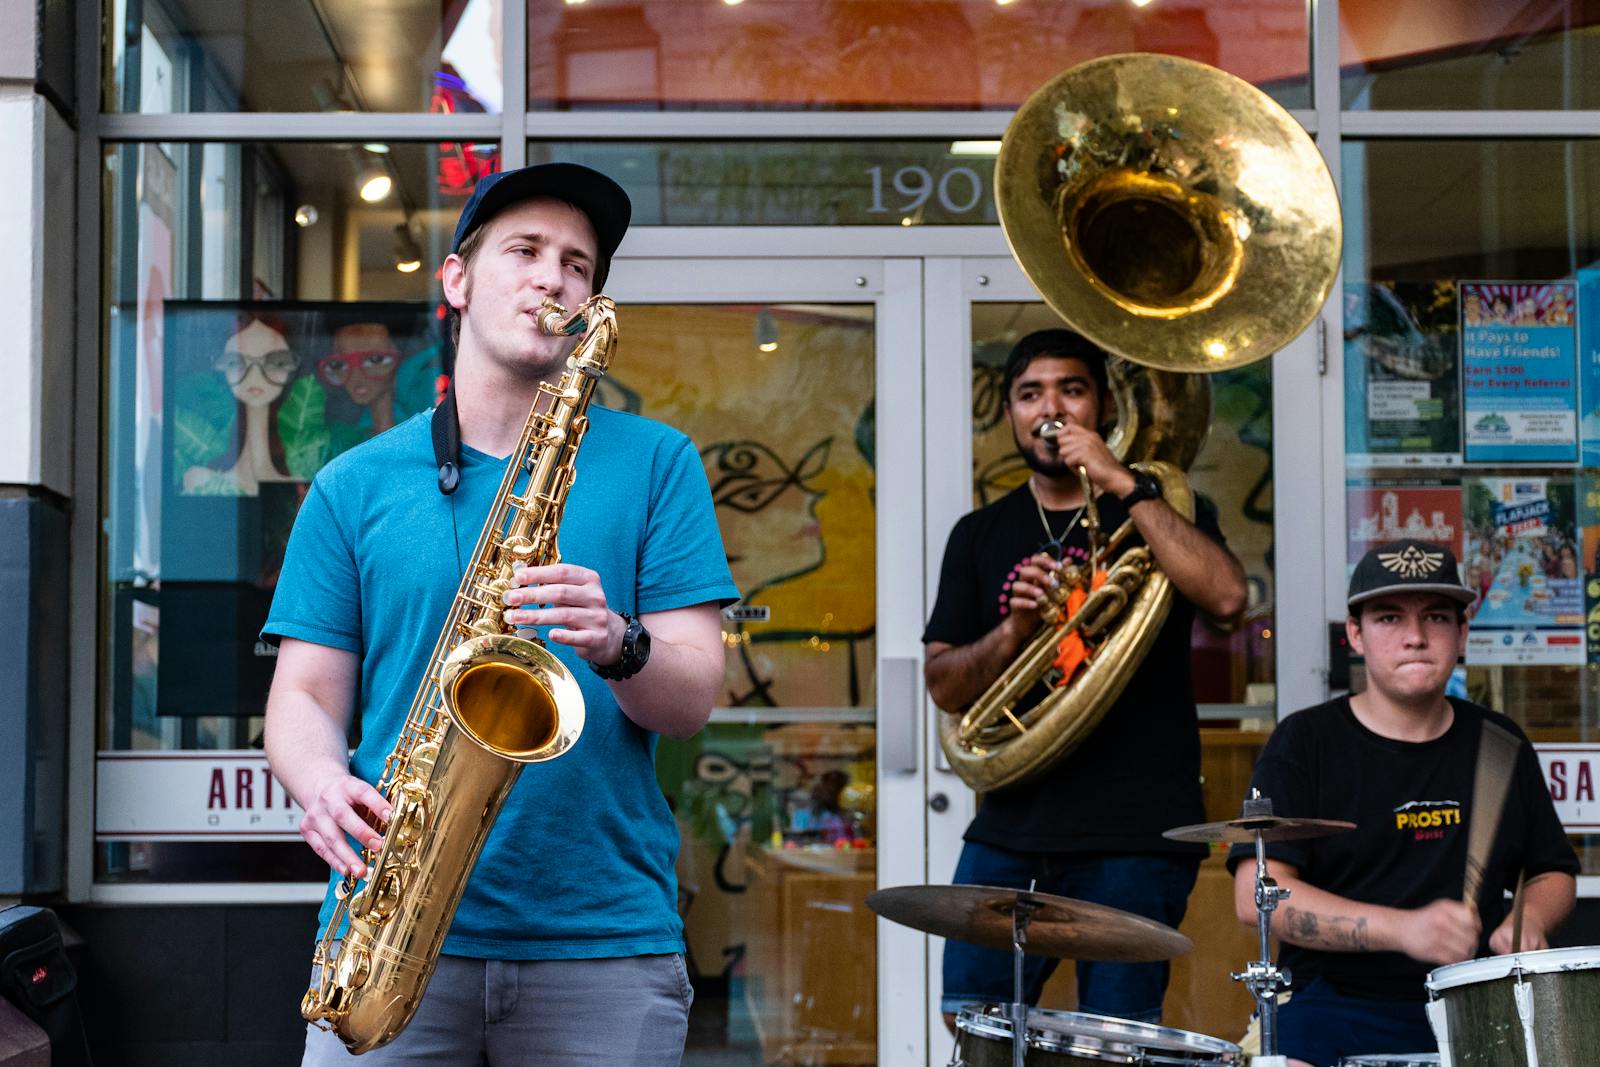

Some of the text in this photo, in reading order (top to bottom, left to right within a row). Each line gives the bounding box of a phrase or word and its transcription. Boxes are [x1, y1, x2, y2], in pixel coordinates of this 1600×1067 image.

[865, 165, 983, 214] 190
[1479, 331, 1511, 344] Pays
[1514, 331, 1529, 343] to
[1465, 345, 1561, 358] Have Friends!
[1488, 378, 1521, 389] Every
[1496, 501, 1550, 525] FLAPJACK
[1550, 761, 1595, 801] SA
[1396, 808, 1462, 830] PROST!
